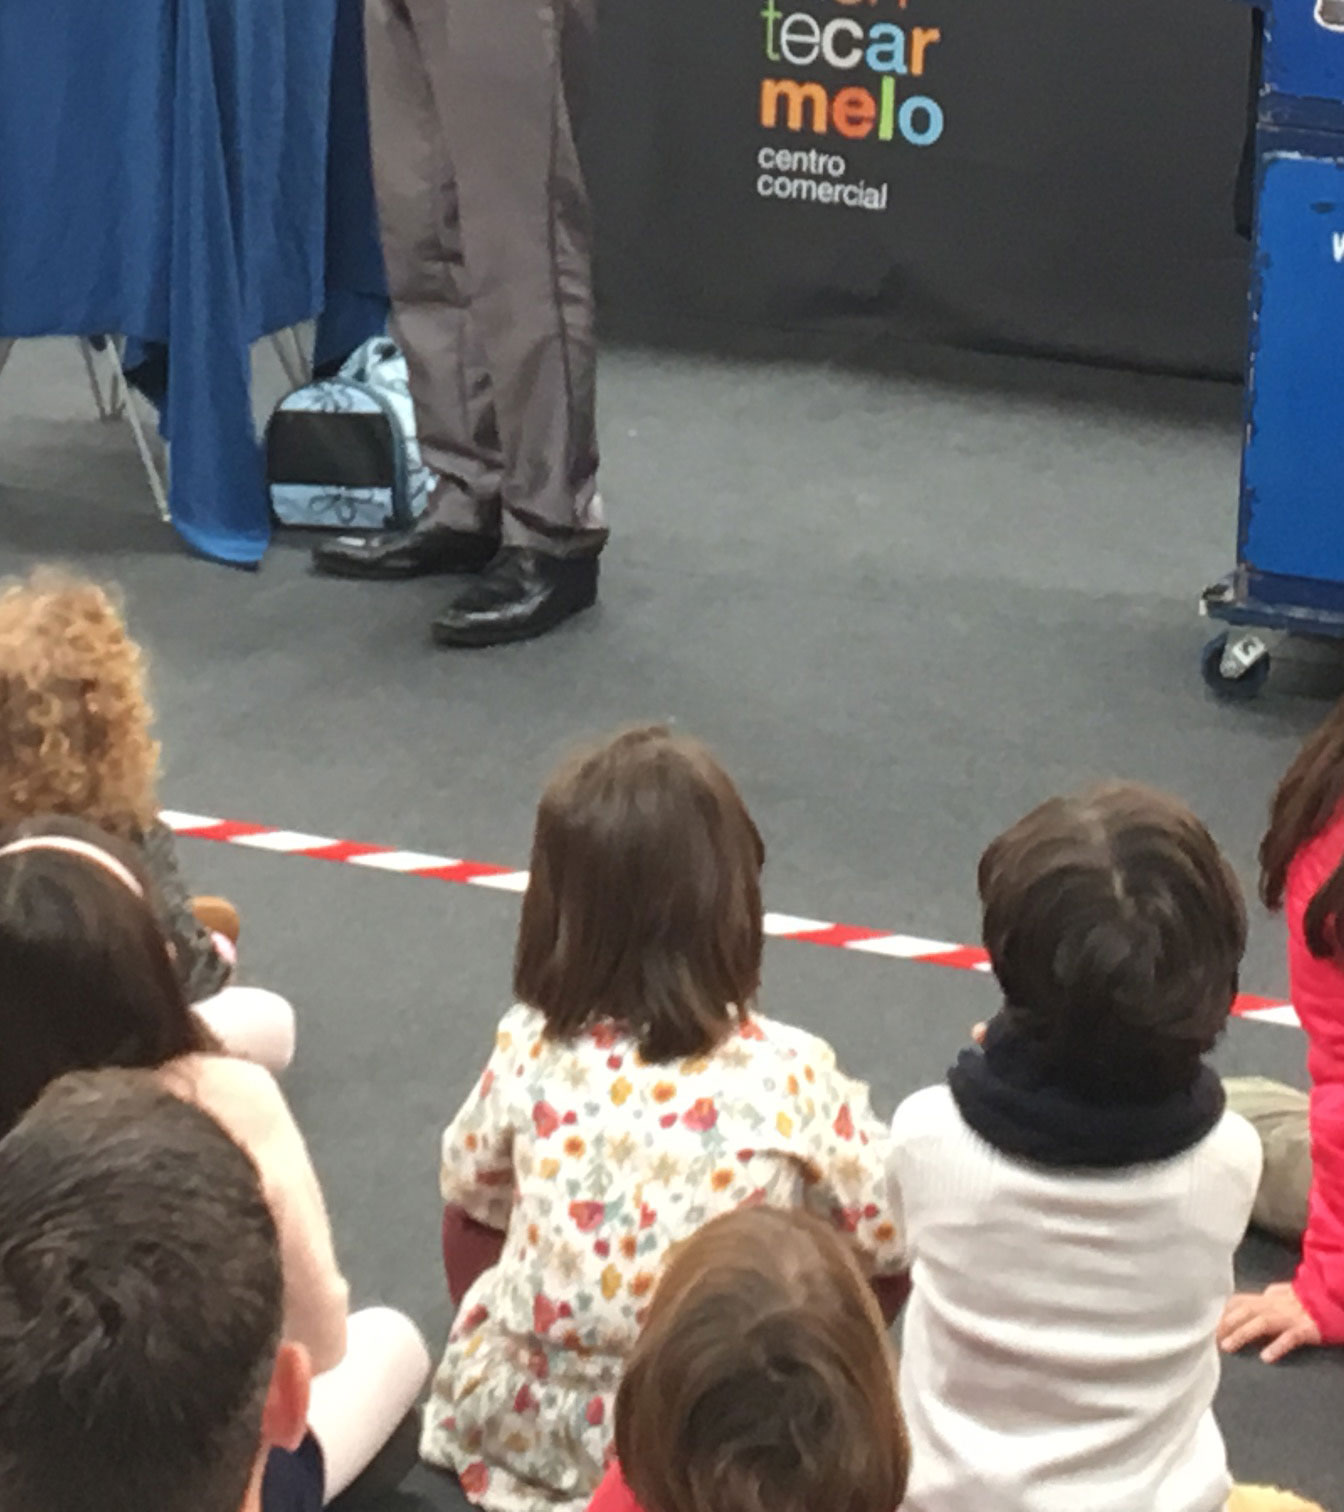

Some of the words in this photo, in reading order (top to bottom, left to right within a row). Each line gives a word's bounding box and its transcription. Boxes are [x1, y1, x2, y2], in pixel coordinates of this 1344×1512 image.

[760, 75, 944, 146] melo
[758, 147, 846, 176] centro
[757, 173, 888, 210] comercial
